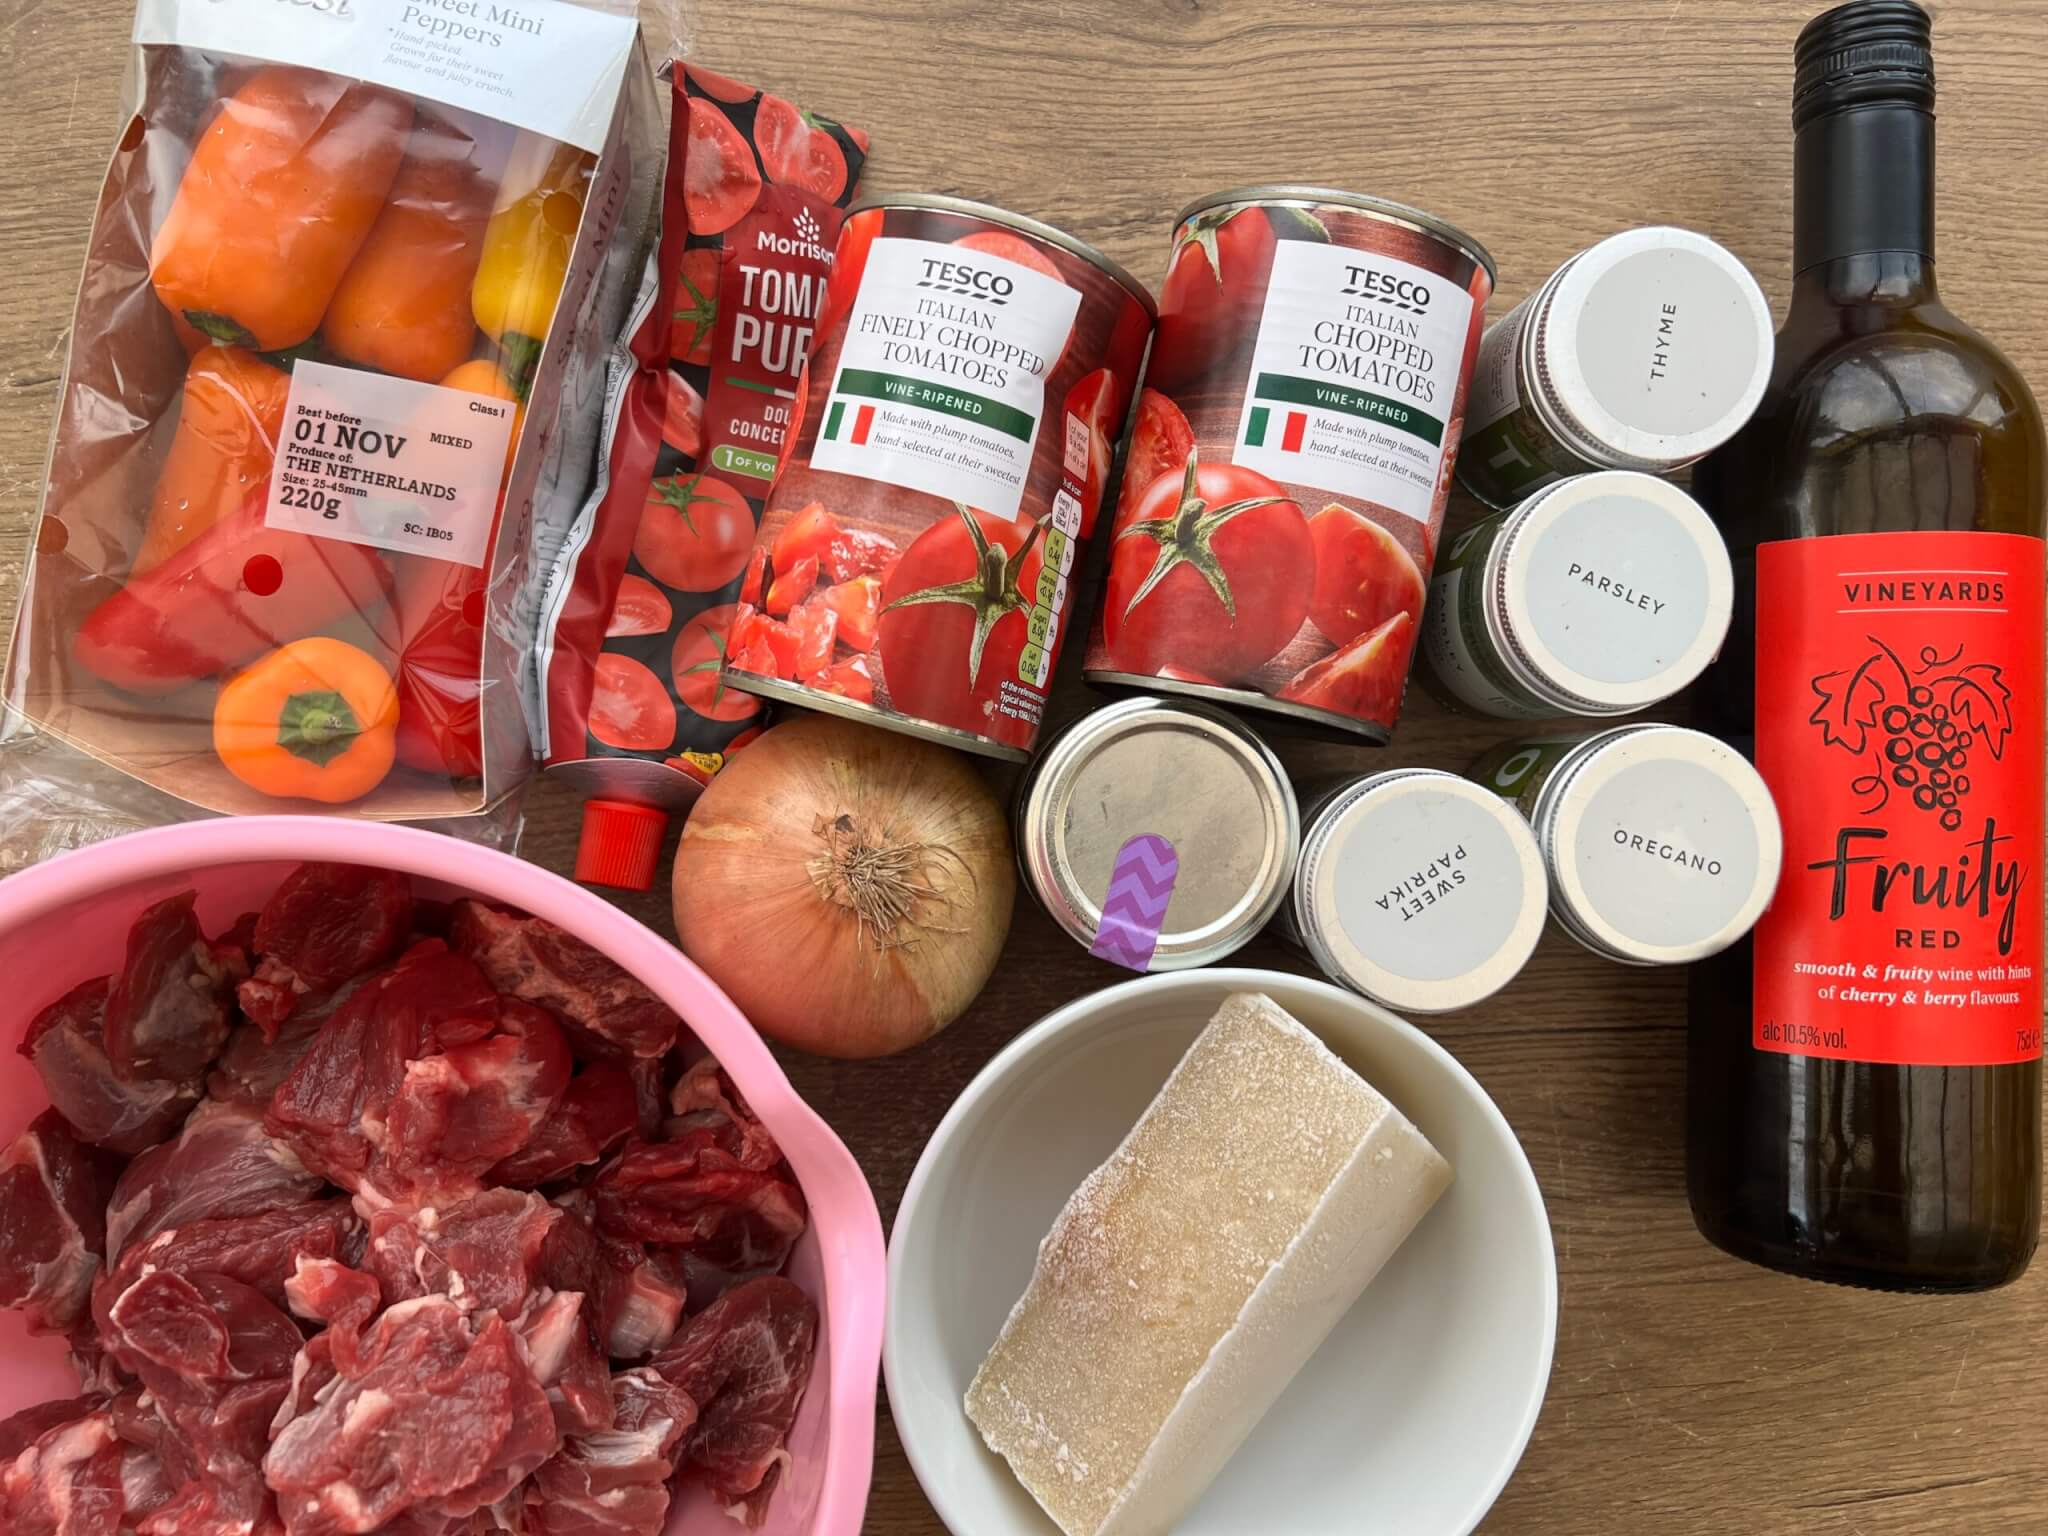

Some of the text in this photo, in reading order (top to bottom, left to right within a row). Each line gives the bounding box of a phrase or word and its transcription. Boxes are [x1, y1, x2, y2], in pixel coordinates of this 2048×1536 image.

[401, 5, 503, 47] Peppers
[410, 0, 545, 35] weet Mini
[394, 30, 425, 45] Hand
[384, 53, 422, 69] flavour
[424, 65, 446, 77] and
[447, 70, 474, 86] juicy
[390, 42, 504, 81] Grown for their sweet
[921, 258, 1013, 297] TESCO
[1345, 265, 1431, 307] TESCO
[916, 299, 997, 330] ITALIAN
[1345, 305, 1420, 339] ITALIAN
[860, 313, 1044, 376] FINELY CHOPPED
[1314, 320, 1434, 373] CHOPPED
[1650, 302, 1677, 381] THYME
[882, 341, 1009, 390] TOMATOES
[1299, 344, 1436, 404] TOMATOES
[298, 405, 361, 425] Best before
[469, 402, 499, 417] Class
[885, 380, 982, 416] VINE-RIPENED
[1316, 387, 1409, 424] VINE-RIPENED
[295, 418, 407, 459] 01 NOV
[430, 432, 472, 450] MIXED
[880, 410, 1016, 460] Made with plump tomatoes,
[1313, 418, 1345, 433] Made
[1346, 424, 1368, 440] with
[1368, 431, 1398, 451] plump
[288, 442, 353, 464] Produce of:
[726, 449, 733, 467] 1
[735, 456, 752, 467] OF
[944, 449, 956, 460] at
[958, 451, 982, 470] their
[984, 461, 1022, 486] sweetest
[1379, 458, 1389, 469] at
[1390, 461, 1409, 477] their
[282, 472, 367, 498] Size: 25-45mm
[286, 455, 457, 501] THE NETHERLANDS
[280, 485, 341, 519] 220g
[404, 523, 453, 541] SC: IB05
[1567, 562, 1666, 616] PARSLEY
[1844, 580, 2006, 604] VINEYARDS
[1612, 829, 1722, 877] OREGANO
[1375, 843, 1468, 912] PAPRIKA
[1806, 817, 2030, 957] Fruity
[1401, 869, 1466, 923] SWEET
[1895, 928, 1961, 950] RED
[1793, 961, 2032, 983] smooth & fruity wine with hints
[1818, 985, 2019, 1009] of cherry & berry flavours
[1762, 1021, 1847, 1049] alc 10.5% vol.
